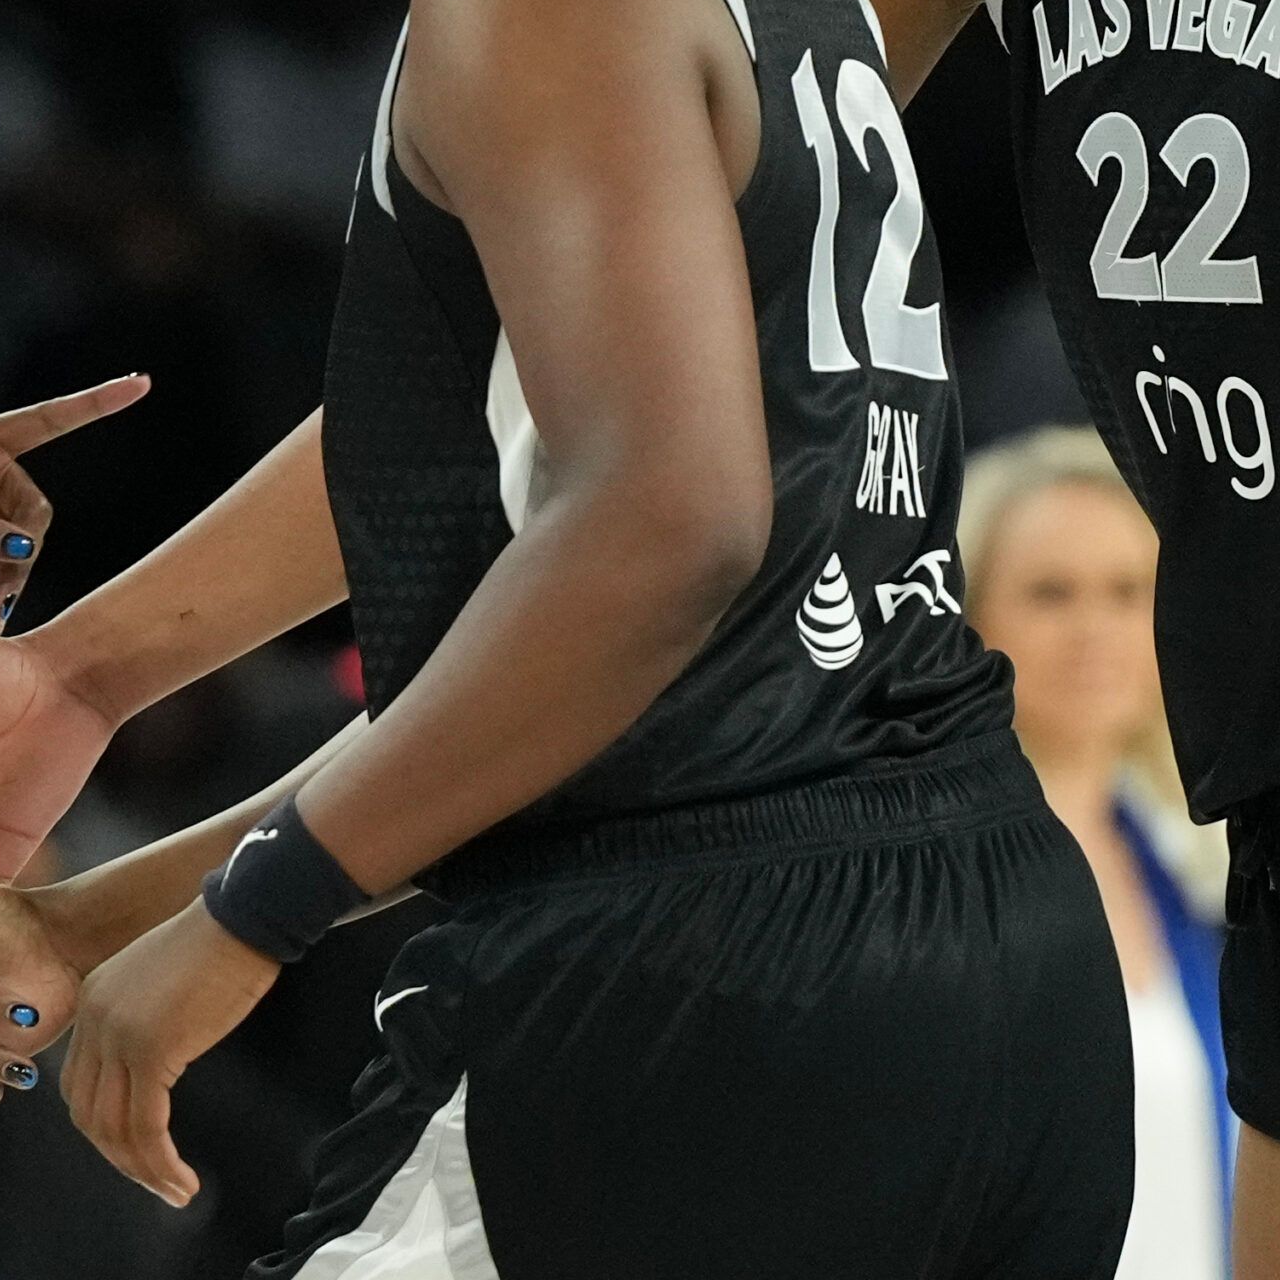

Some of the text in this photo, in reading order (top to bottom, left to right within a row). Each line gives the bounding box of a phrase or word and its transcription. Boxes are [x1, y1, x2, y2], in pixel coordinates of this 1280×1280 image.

[790, 47, 950, 382] 12
[1075, 111, 1264, 307] 22
[855, 400, 928, 519] GRAY
[1135, 344, 1277, 502] ring
